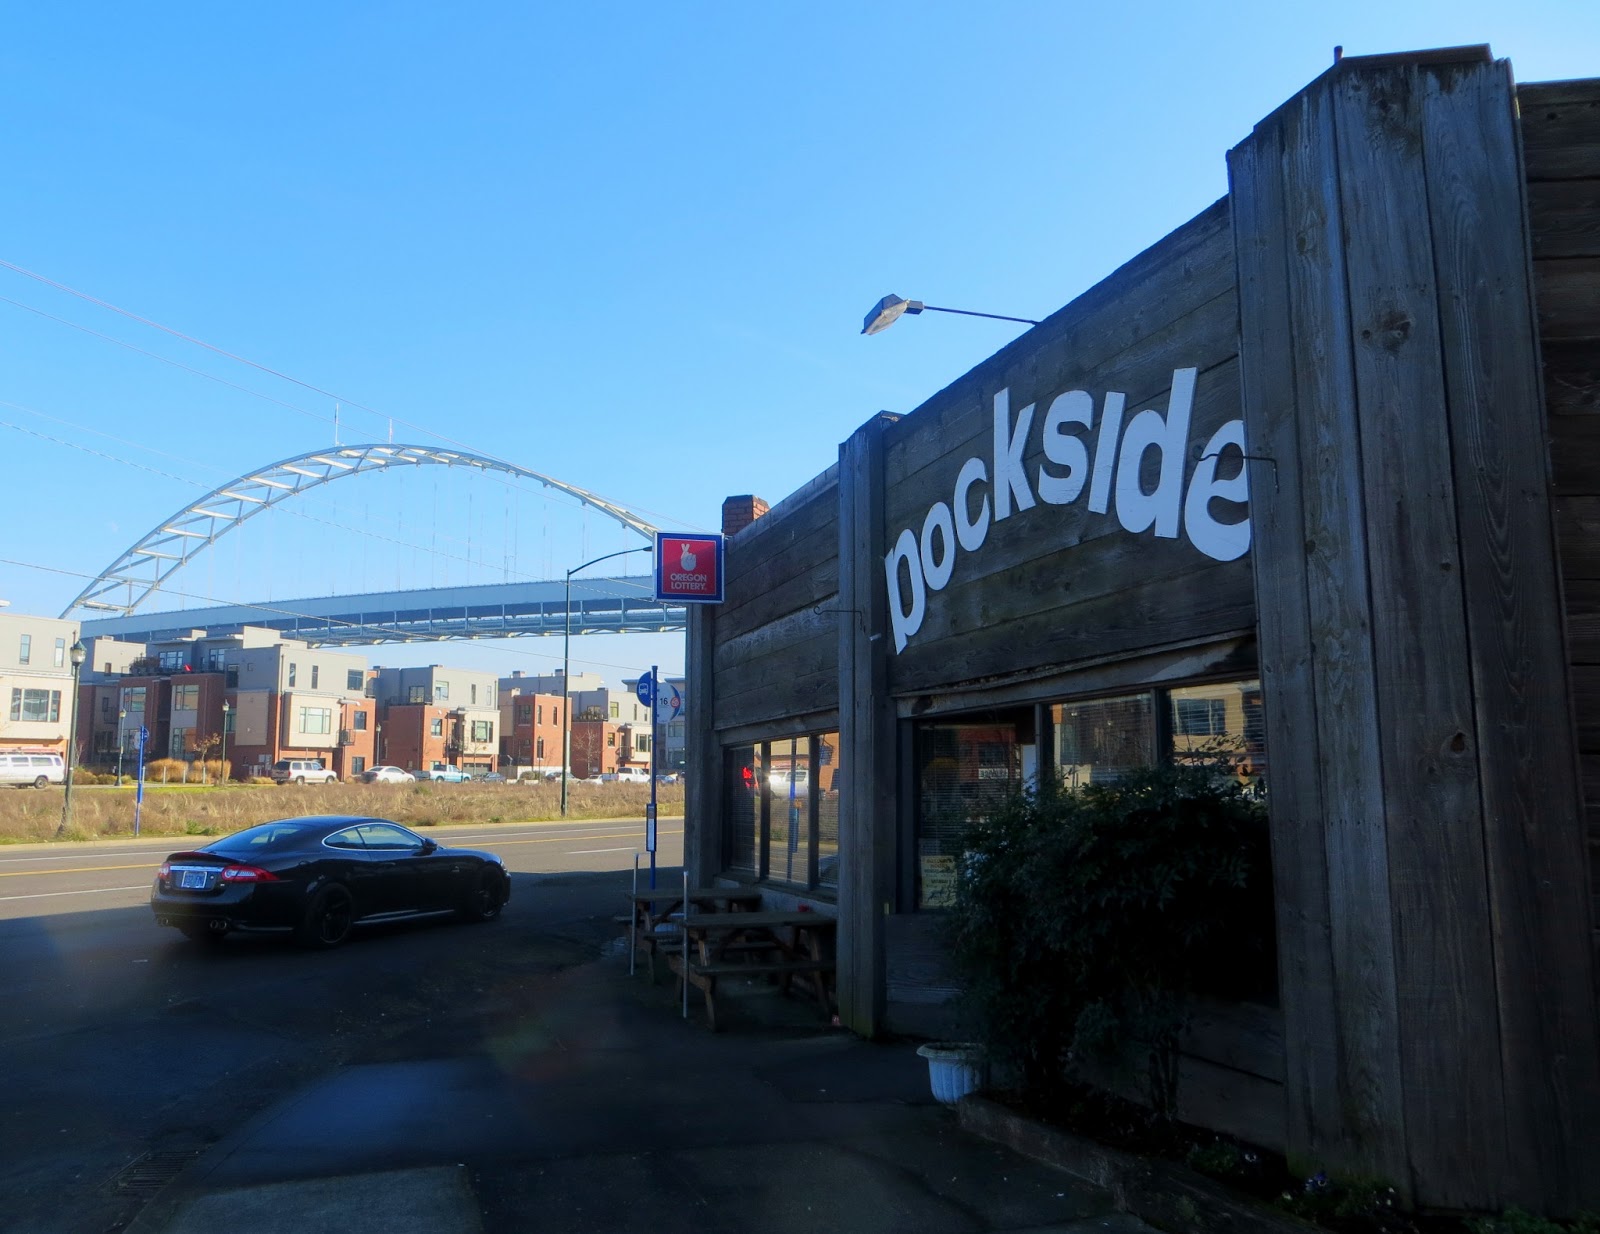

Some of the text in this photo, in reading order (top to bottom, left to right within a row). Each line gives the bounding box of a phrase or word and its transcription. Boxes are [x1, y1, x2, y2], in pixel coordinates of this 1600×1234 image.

[670, 573, 707, 582] OREGON
[671, 582, 706, 590] LOTTERY
[660, 697, 668, 706] 16
